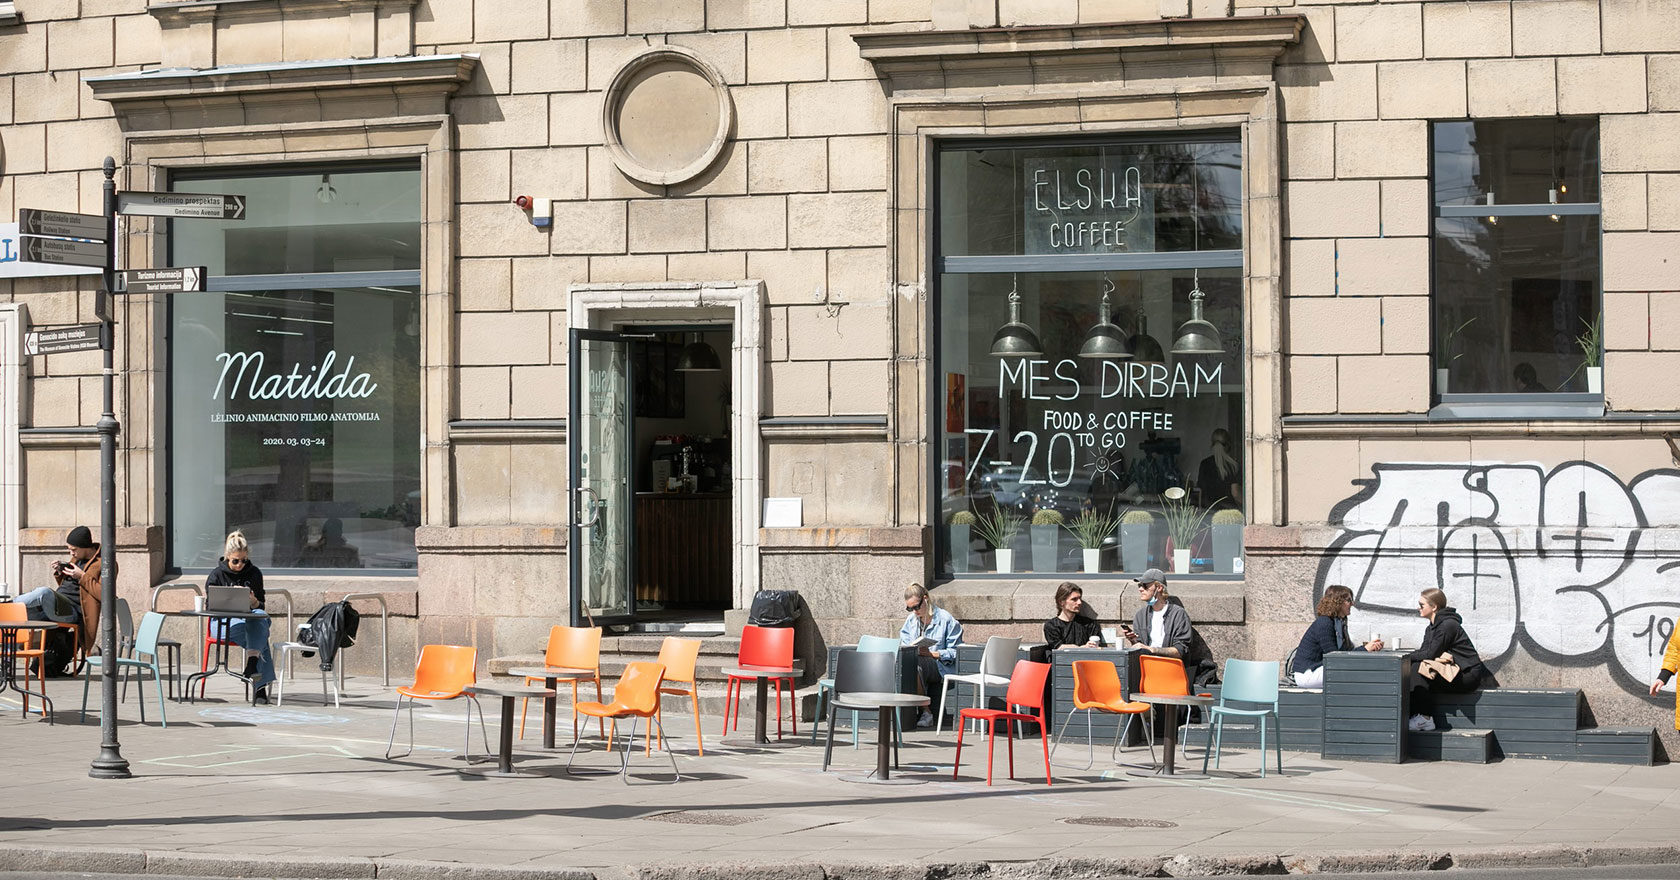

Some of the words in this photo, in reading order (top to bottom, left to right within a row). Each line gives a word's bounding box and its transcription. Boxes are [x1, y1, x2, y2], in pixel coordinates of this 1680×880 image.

[1034, 166, 1141, 211] ELSKA
[153, 195, 184, 205] Gedimino
[185, 196, 221, 206] prospektas
[1050, 221, 1125, 248] COFFEE
[212, 350, 378, 400] Matilda
[999, 358, 1080, 401] MES
[1101, 360, 1223, 398] DIRBAM
[210, 412, 245, 423] LĖLINIO
[245, 413, 299, 422] ANIMACINIO
[300, 412, 329, 422] FILMO
[329, 412, 381, 421] ANATOMIJA
[1043, 410, 1082, 430] FOOD
[1086, 412, 1099, 430] &
[1103, 411, 1173, 431] COFFEE
[286, 438, 299, 446] 03.
[1075, 433, 1095, 447] TO
[1102, 432, 1126, 449] GO
